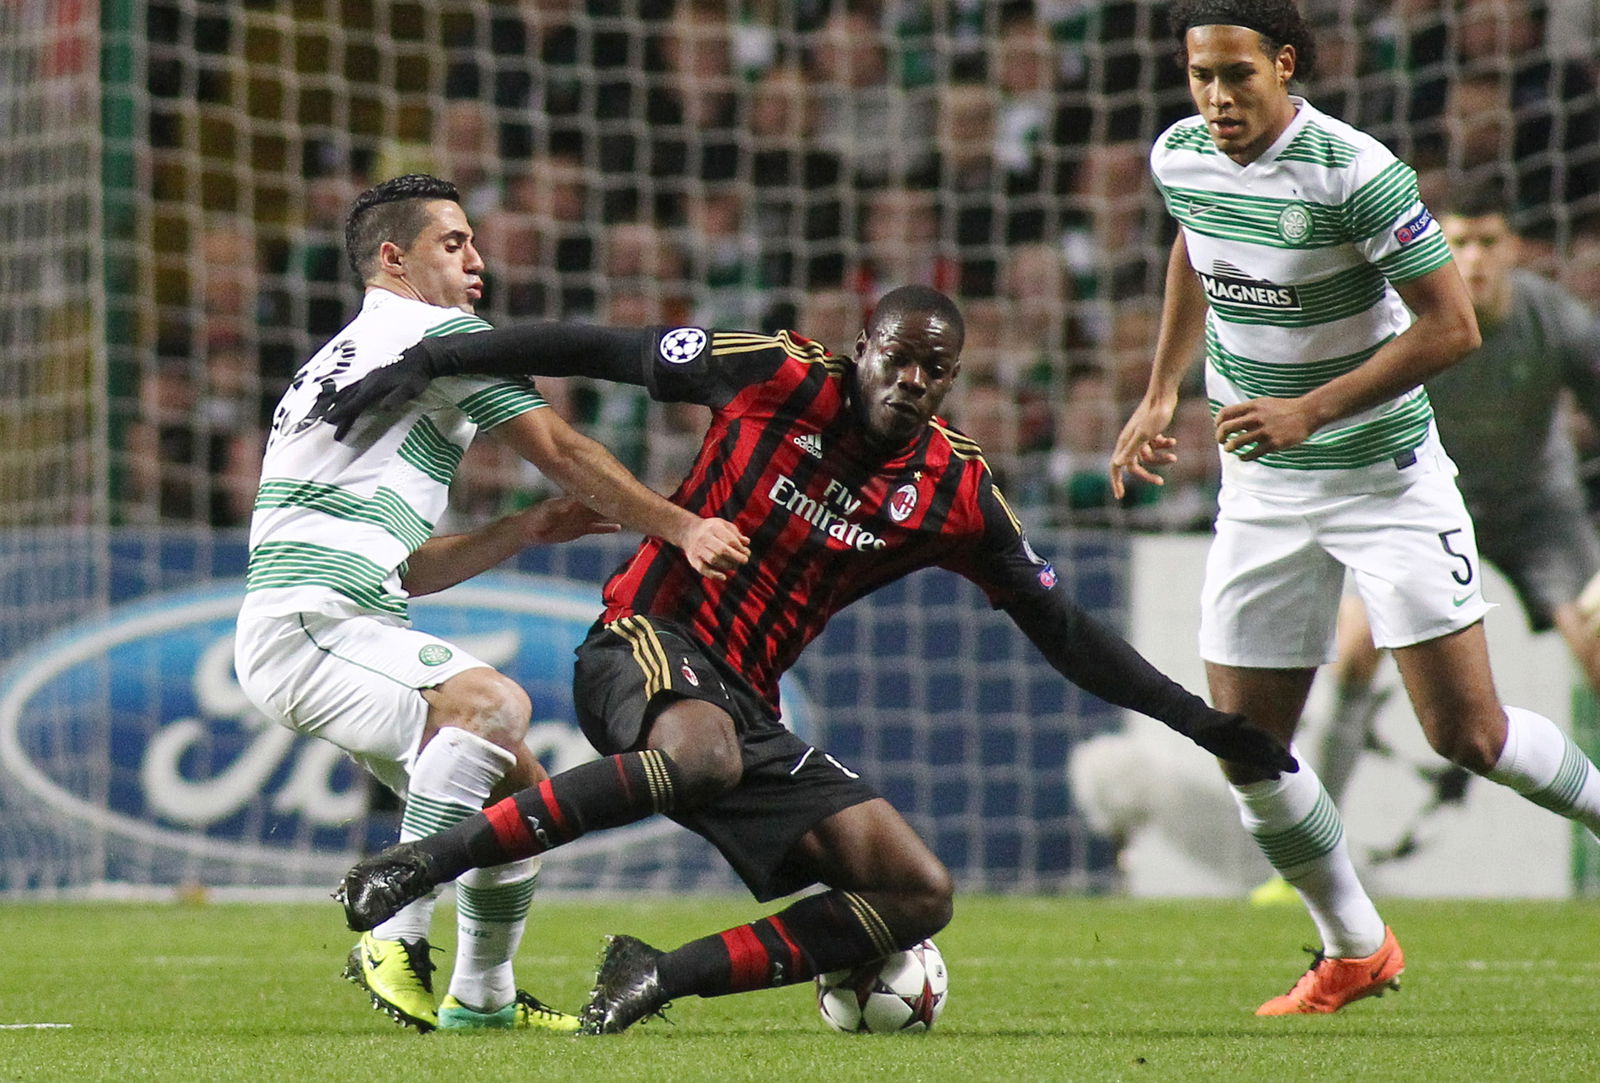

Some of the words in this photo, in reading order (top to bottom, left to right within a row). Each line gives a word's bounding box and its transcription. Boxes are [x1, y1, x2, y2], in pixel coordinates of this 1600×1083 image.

[1201, 275, 1293, 305] MAGNERS
[769, 474, 887, 552] Emirates
[824, 479, 861, 515] Fly
[1438, 528, 1473, 586] 5
